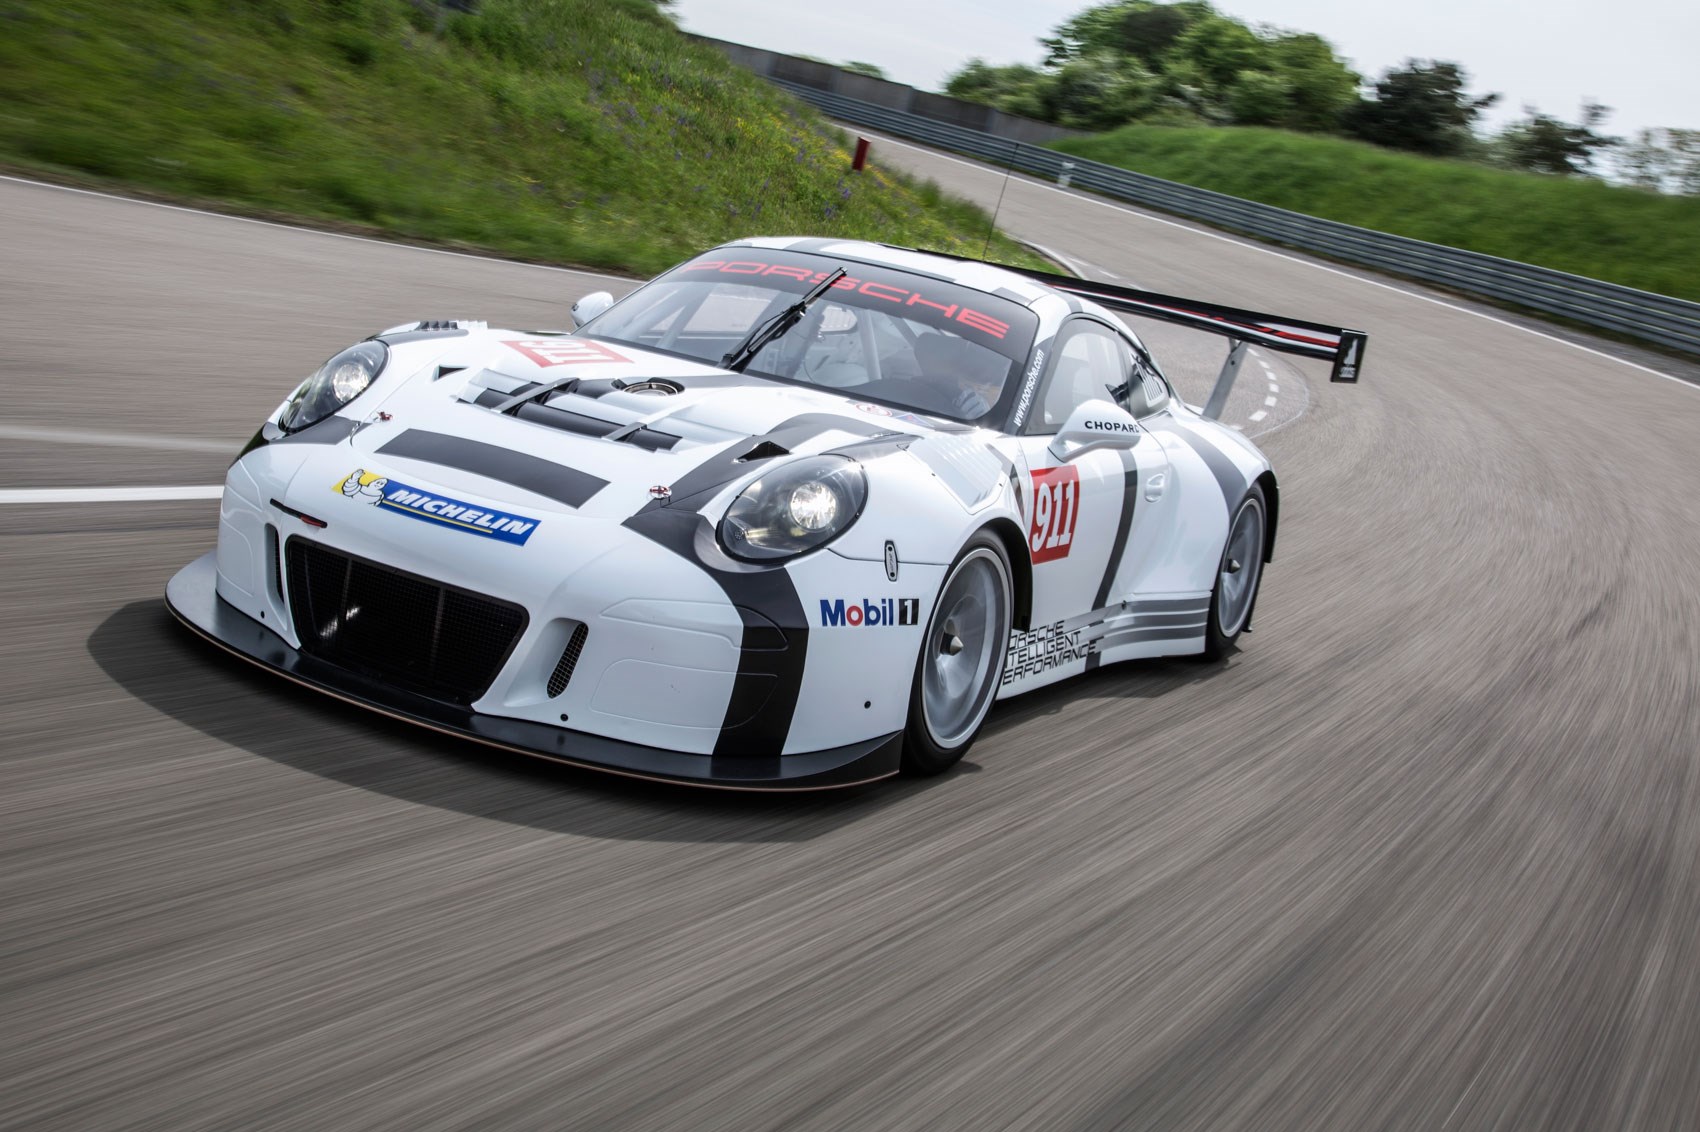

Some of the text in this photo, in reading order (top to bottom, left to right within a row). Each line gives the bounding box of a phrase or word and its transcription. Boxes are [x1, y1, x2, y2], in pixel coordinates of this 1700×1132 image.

[680, 261, 1010, 340] PORSCHE
[1013, 349, 1045, 427] www.porsche.com
[386, 489, 534, 536] MICHELIN
[1031, 479, 1075, 553] 911
[820, 598, 894, 627] Mobil
[1009, 620, 1065, 651] ORSCHE
[1002, 641, 1097, 686] ERFORMANCE
[1008, 631, 1081, 667] TELLIGENT
